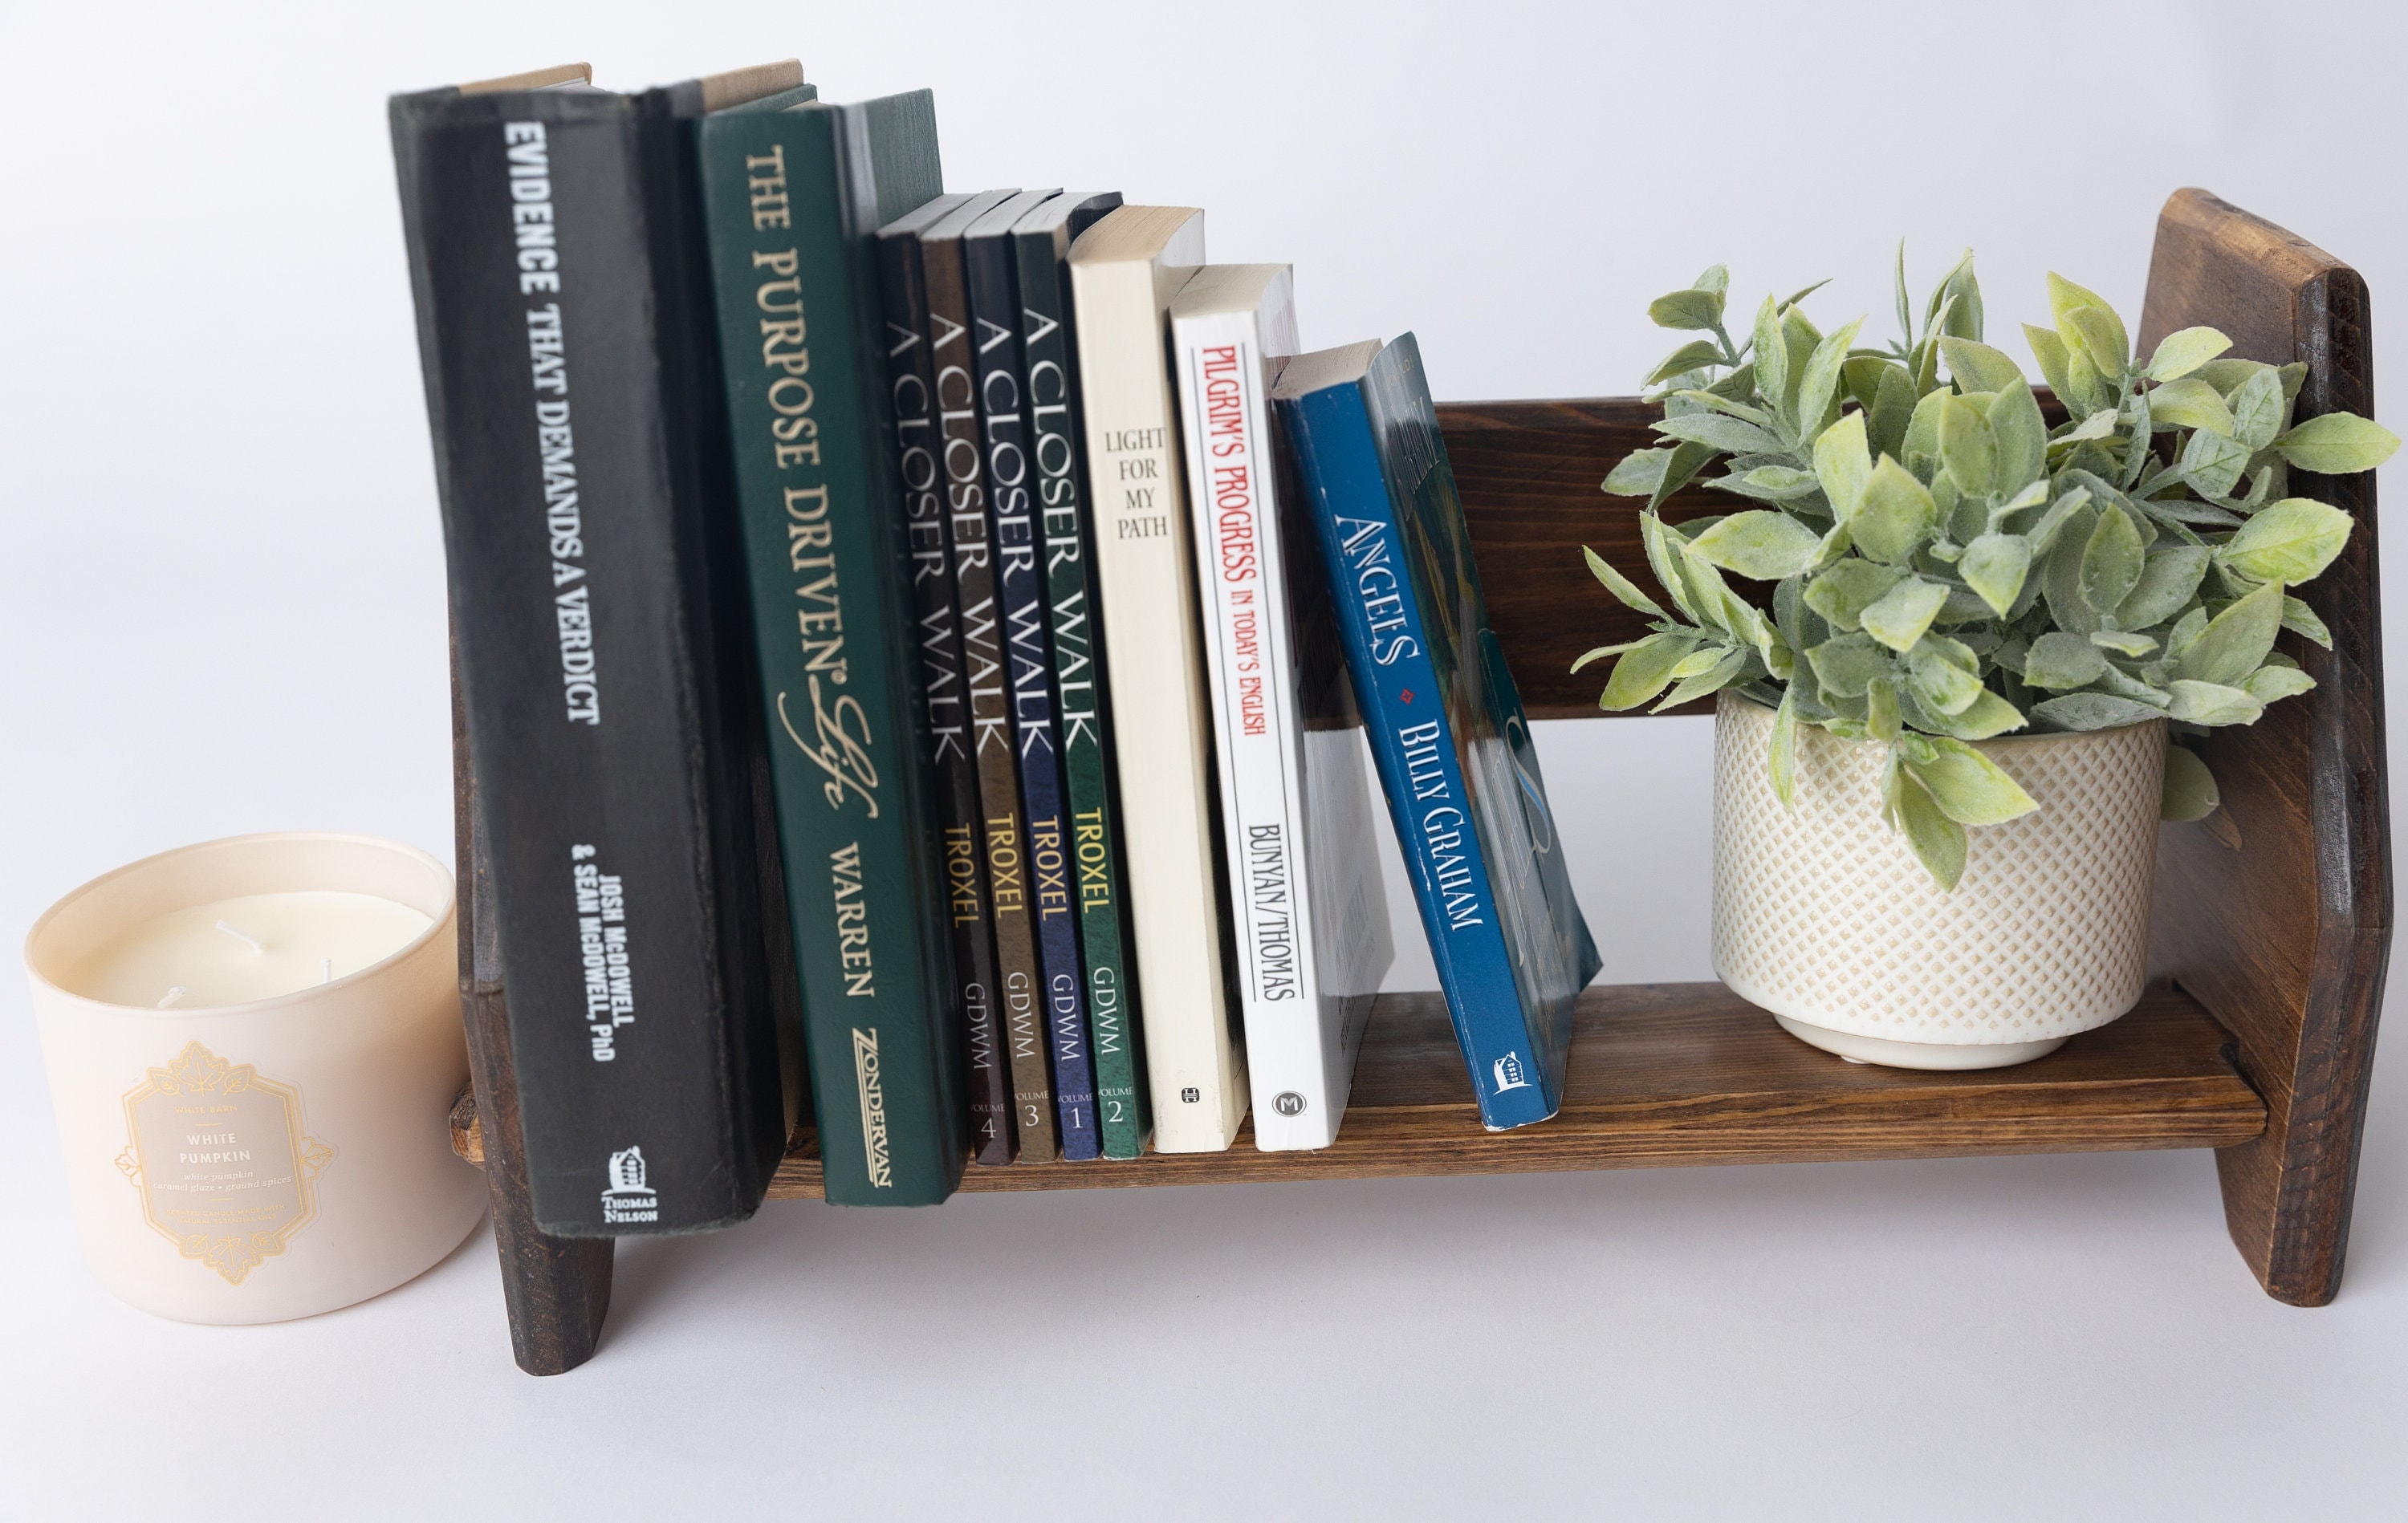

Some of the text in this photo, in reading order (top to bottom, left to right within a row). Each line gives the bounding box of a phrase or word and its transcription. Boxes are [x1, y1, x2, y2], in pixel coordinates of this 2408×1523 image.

[746, 144, 791, 230] THE
[753, 248, 820, 469] PURPOSE
[504, 120, 600, 725] EVIDENCE THAT DEMANDS A VERDICT
[1105, 428, 1165, 453] LIGHT
[1119, 457, 1159, 480] FOR
[1125, 487, 1156, 510] MY
[885, 321, 966, 764] A CLOSER WALK
[930, 312, 1011, 757] A CLOSER WALK
[977, 317, 1054, 757] A CLOSER WALK
[1023, 308, 1097, 753] A CLOSER WALK
[1117, 516, 1168, 540] PATH
[1203, 346, 1266, 737] PILGRIM'S PROGRESS IN TODAY'S ENGLISH
[1334, 514, 1421, 666] ANGELS
[777, 674, 879, 818] Life
[571, 844, 596, 860] &
[987, 812, 1023, 919] TROXEL
[1032, 815, 1068, 921] TROXEL
[1076, 806, 1109, 914] TROXEL
[1398, 719, 1483, 932] BILLY GRAHAM
[574, 864, 600, 913] SEAN
[945, 822, 979, 928] TROXEL
[1248, 823, 1296, 1001] BUNYAN/THOMAS
[598, 874, 635, 1028] JOSH McDOWELL
[830, 842, 875, 999] WARREN
[590, 1024, 616, 1062] PhD
[965, 983, 992, 1070] GDWM
[1007, 972, 1036, 1060] GDWM
[1052, 973, 1080, 1062] GDWM
[1093, 966, 1121, 1056] GDWM
[186, 1133, 236, 1145] WHITE
[209, 1105, 238, 1113] BARN
[852, 1027, 893, 1188] ZONDERVAN
[981, 1118, 996, 1139] 4
[1025, 1105, 1039, 1127] 3
[1071, 1107, 1083, 1129] 1
[1108, 1101, 1124, 1123] 2
[153, 1176, 293, 1192] caramel glaze ground spices
[180, 1150, 251, 1164] PUMPKIN
[212, 1171, 254, 1181] pumpkin
[601, 1195, 658, 1211] THOMAS
[604, 1208, 658, 1224] NELSON
